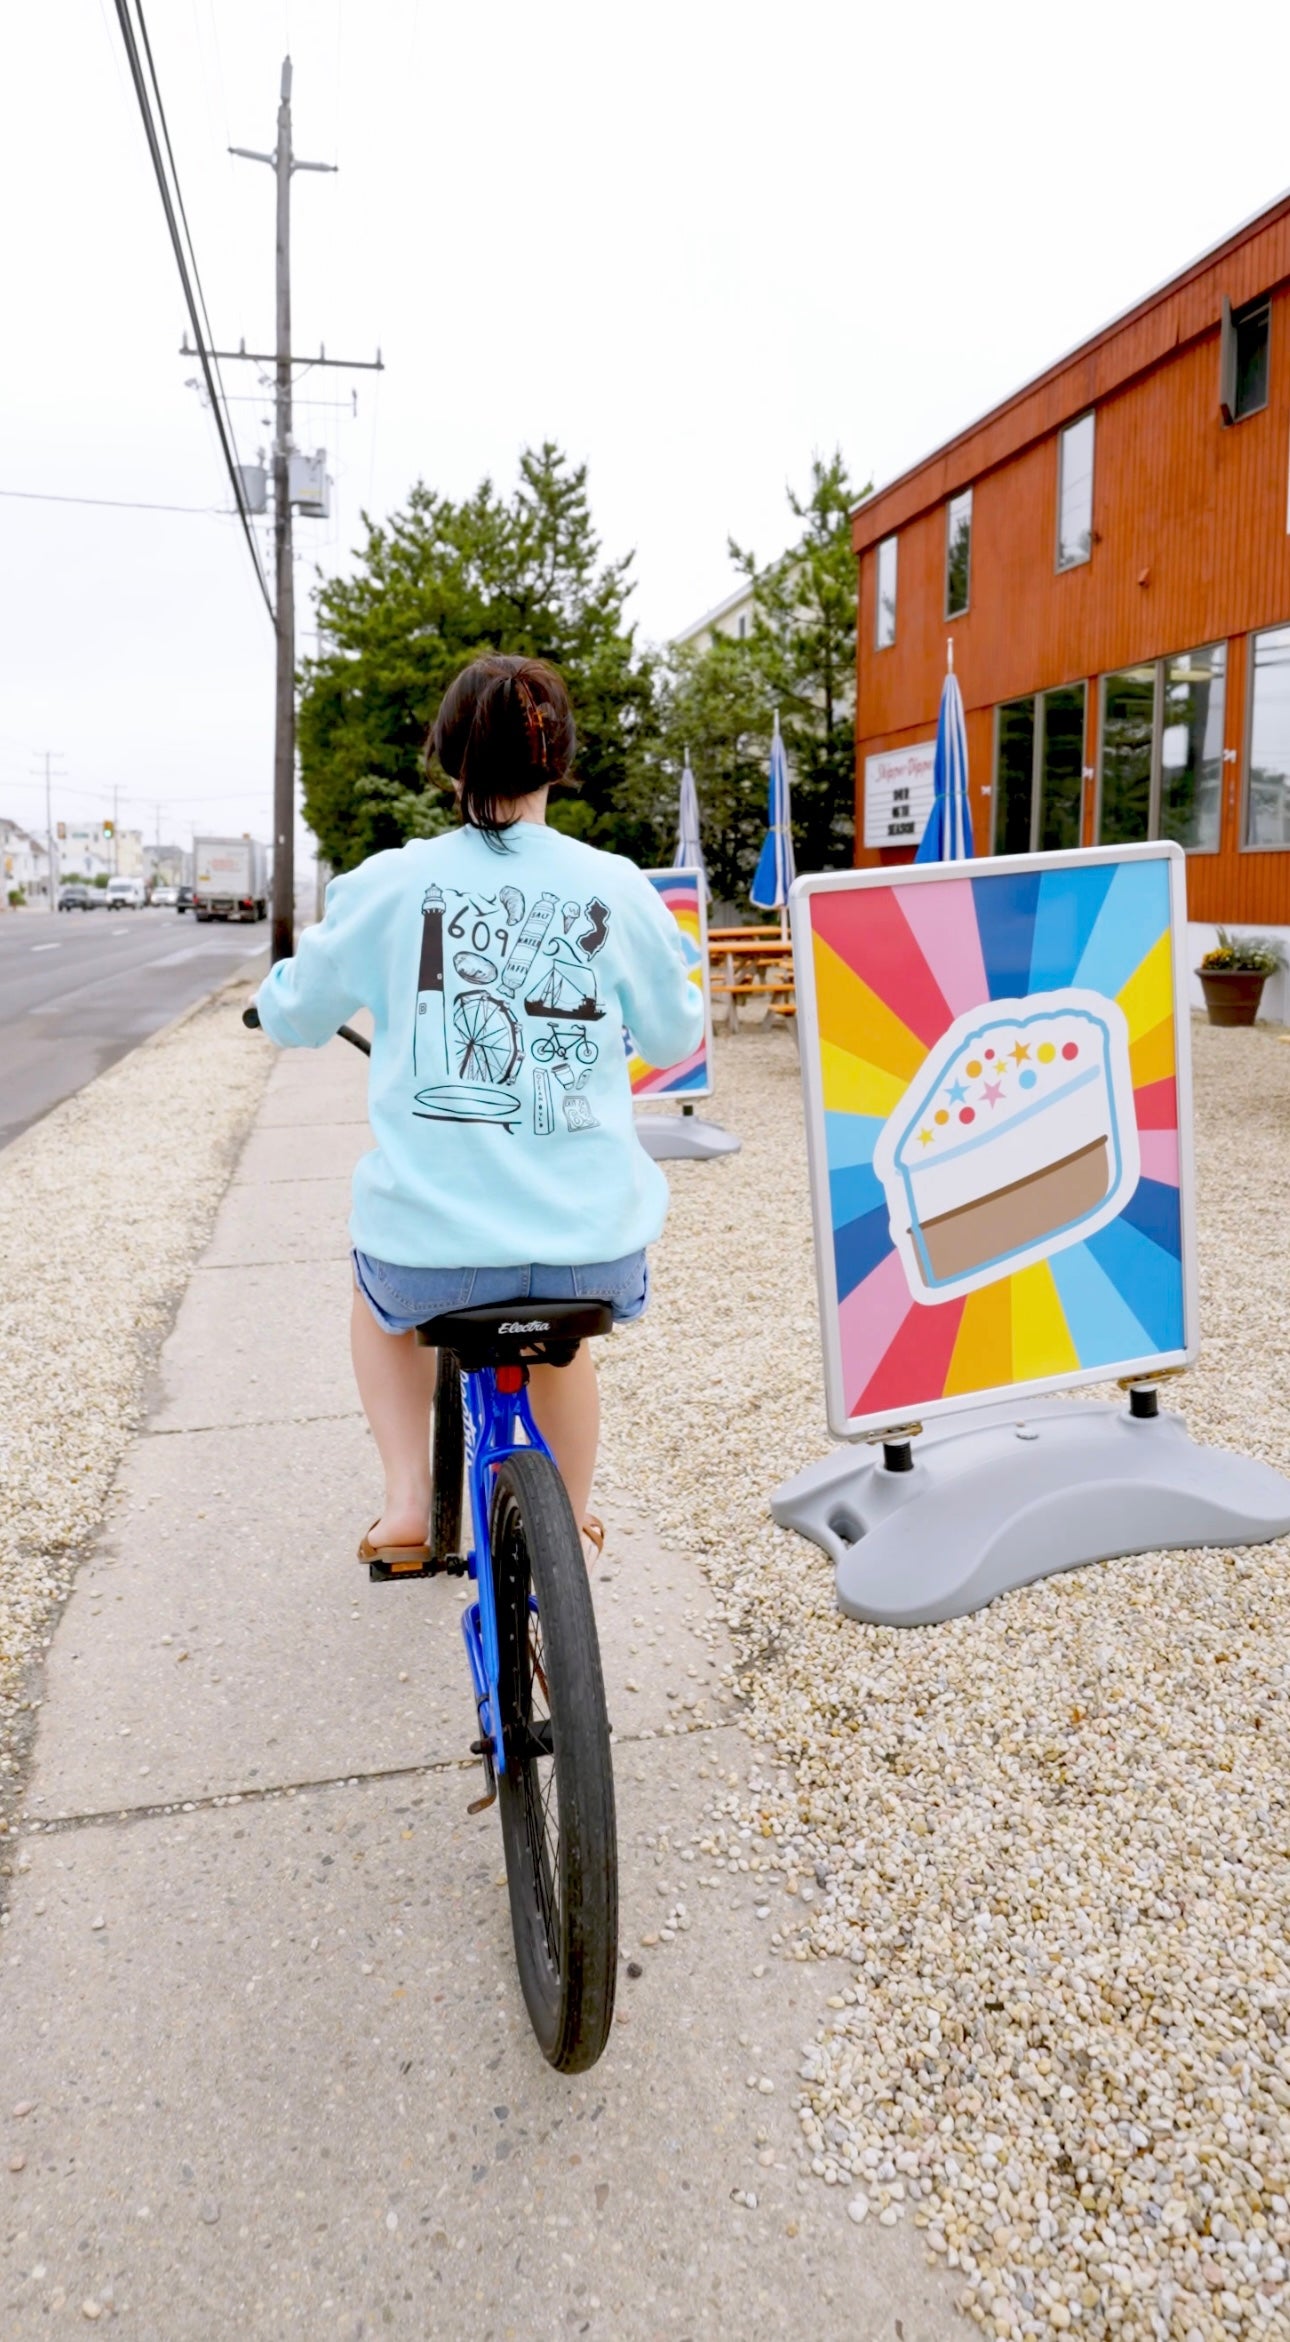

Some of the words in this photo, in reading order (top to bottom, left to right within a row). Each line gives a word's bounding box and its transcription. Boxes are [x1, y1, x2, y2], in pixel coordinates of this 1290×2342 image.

[531, 911, 550, 920] SALT
[447, 906, 509, 957] 609
[498, 1320, 551, 1335] Electra
